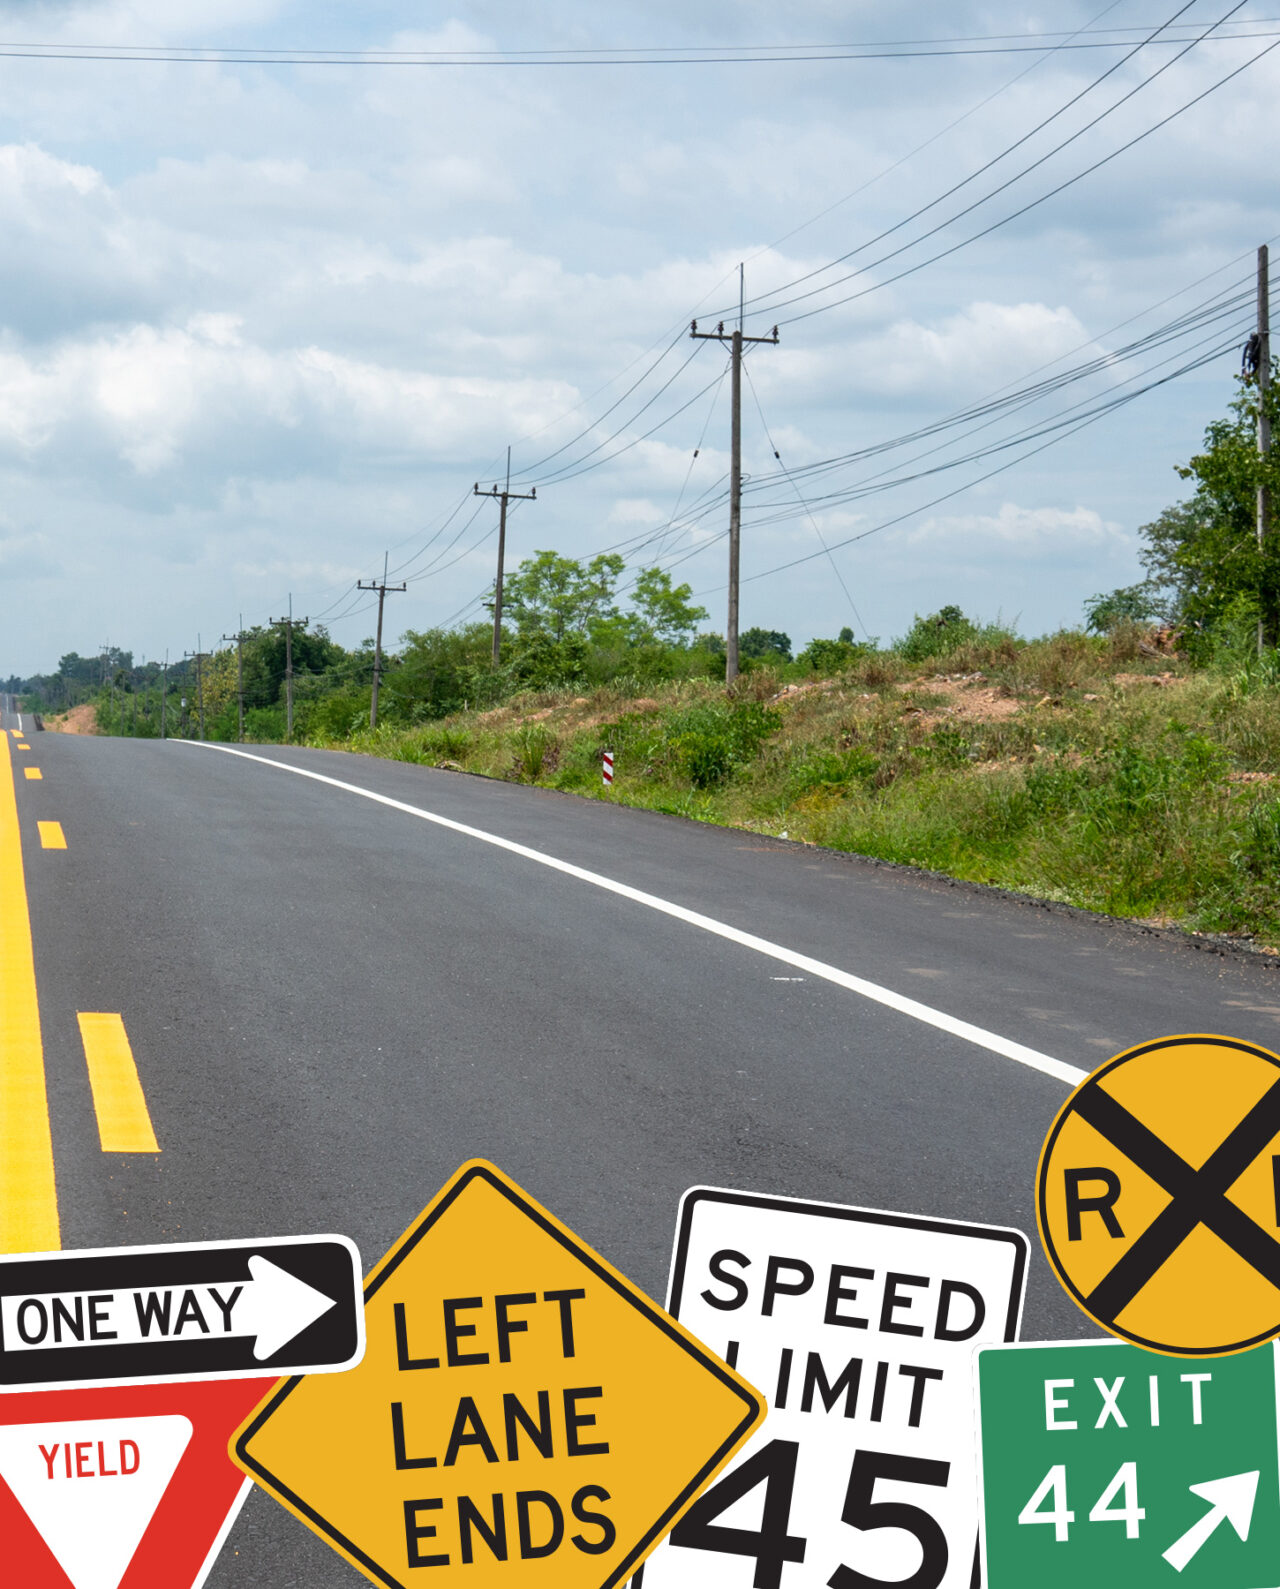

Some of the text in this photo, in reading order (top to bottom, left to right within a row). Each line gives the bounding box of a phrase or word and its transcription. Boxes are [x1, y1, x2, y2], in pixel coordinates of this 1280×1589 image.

[1063, 1166, 1126, 1242] R
[17, 1286, 244, 1345] ONE WAY
[393, 1288, 586, 1371] LEFT
[700, 1249, 986, 1342] SPEED
[390, 1386, 610, 1471] LANE
[1043, 1372, 1212, 1431] EXIT
[38, 1439, 141, 1480] YIELD
[403, 1484, 617, 1569] ENDS
[668, 1438, 951, 1589] 45
[1017, 1461, 1146, 1542] 44
